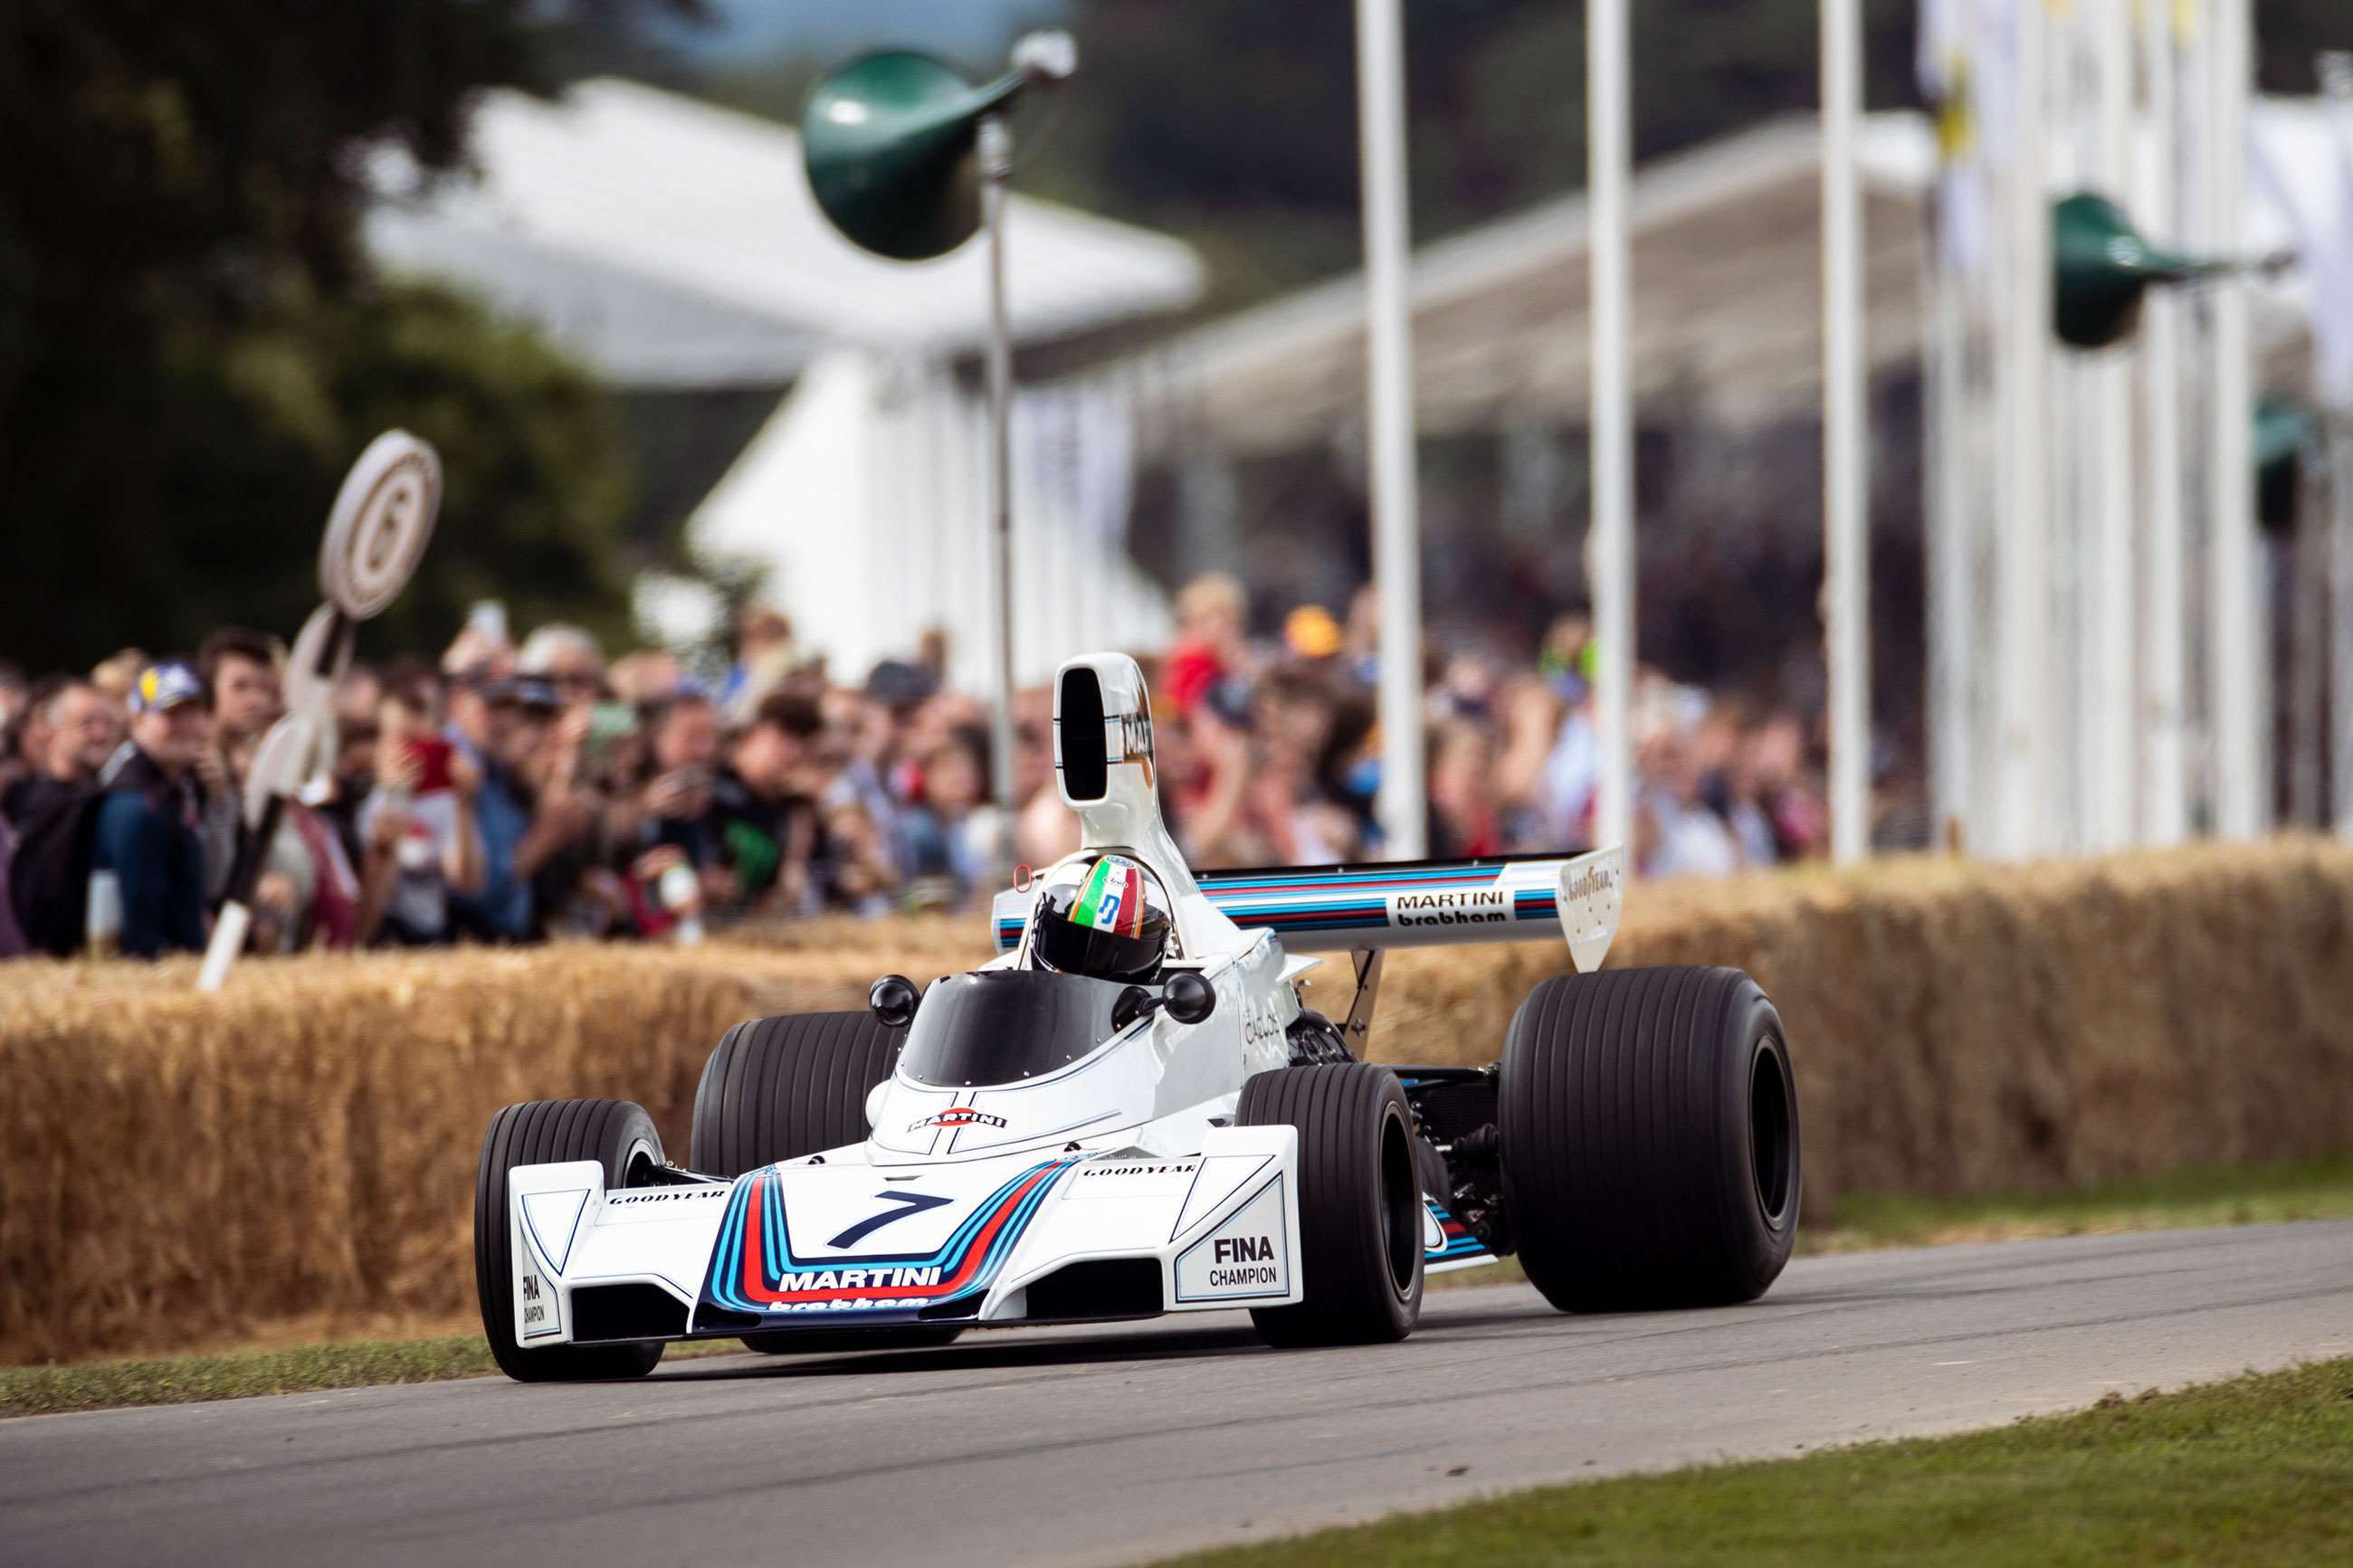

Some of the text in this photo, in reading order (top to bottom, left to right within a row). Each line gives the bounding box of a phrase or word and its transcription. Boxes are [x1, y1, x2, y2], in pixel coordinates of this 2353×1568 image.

[1396, 891, 1503, 909] MARTINI
[1397, 911, 1507, 927] brabham
[907, 1112, 1006, 1133] MARTINI
[1084, 1164, 1196, 1176] GOODYEAR
[609, 1191, 725, 1205] GOODYEAR
[826, 1190, 955, 1250] 7
[1214, 1236, 1274, 1263] FINA
[778, 1267, 942, 1292] MARTINI
[1209, 1267, 1277, 1286] CHAMPION
